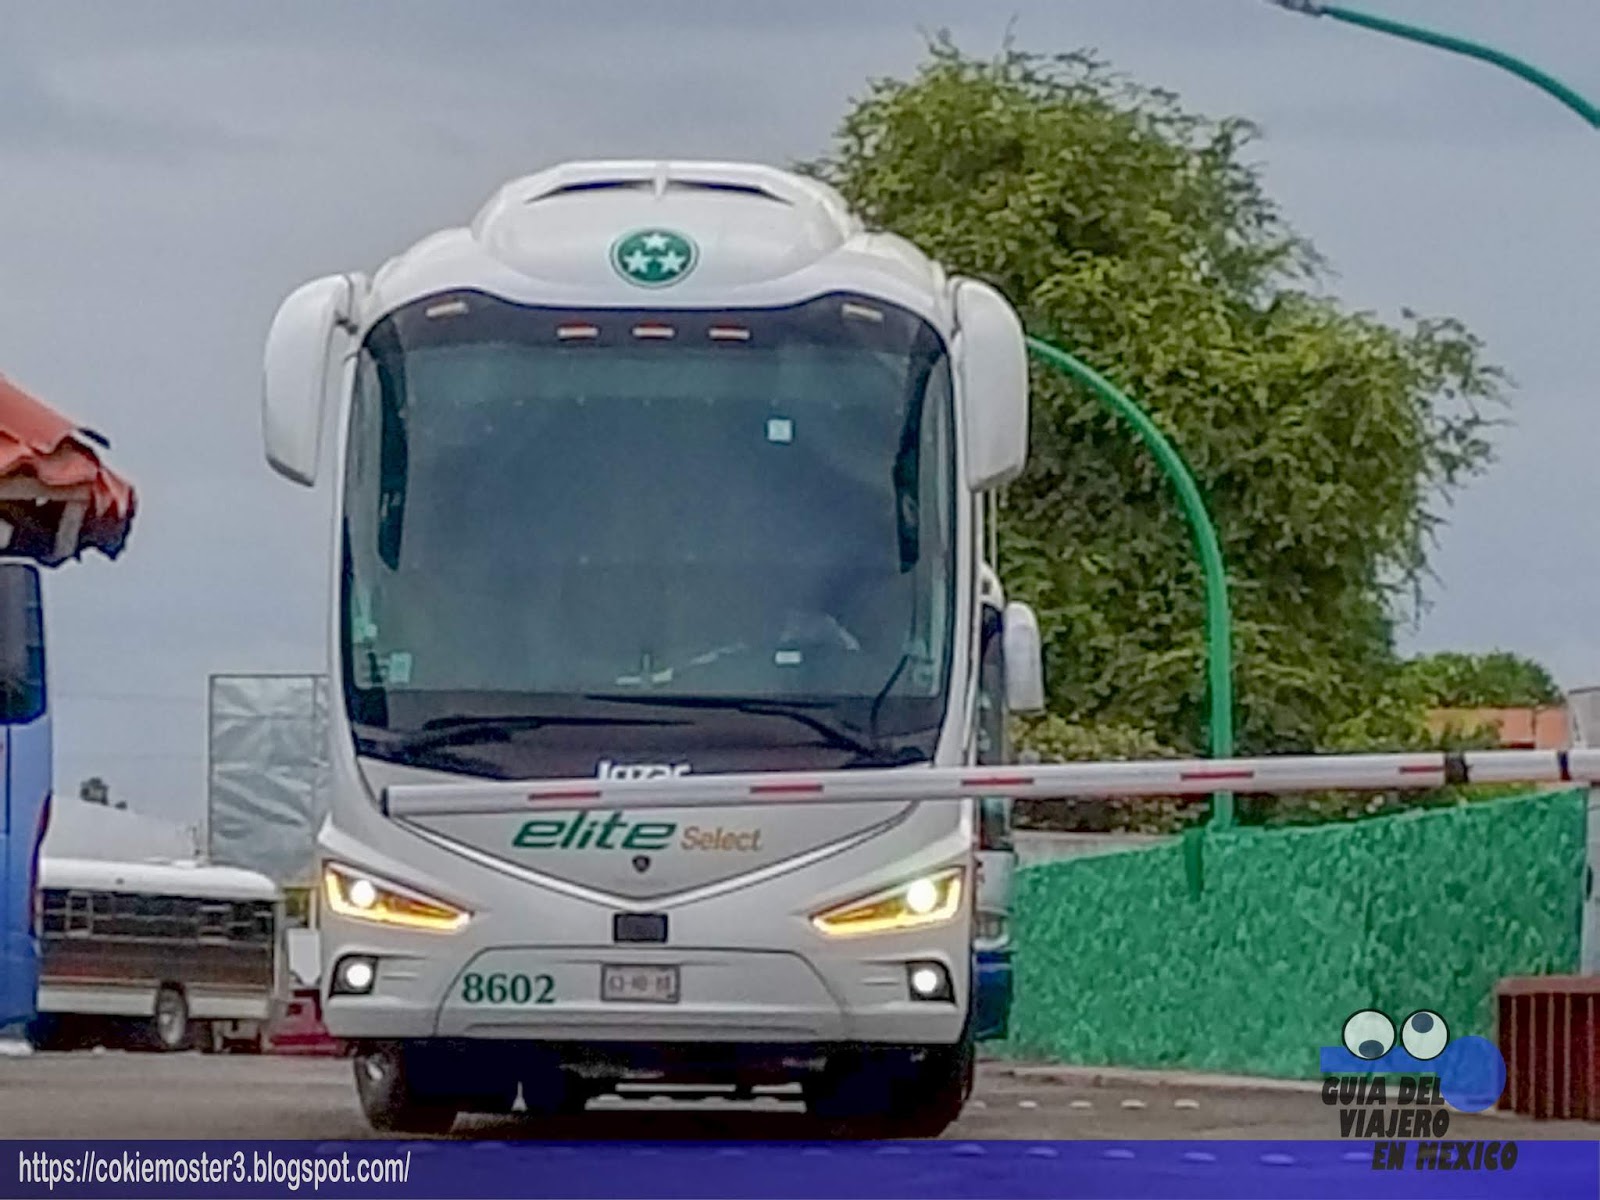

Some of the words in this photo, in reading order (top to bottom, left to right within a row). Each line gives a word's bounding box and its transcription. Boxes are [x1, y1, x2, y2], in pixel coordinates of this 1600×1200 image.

[512, 811, 677, 850] elite
[680, 826, 762, 850] Select
[462, 973, 555, 1004] 8602
